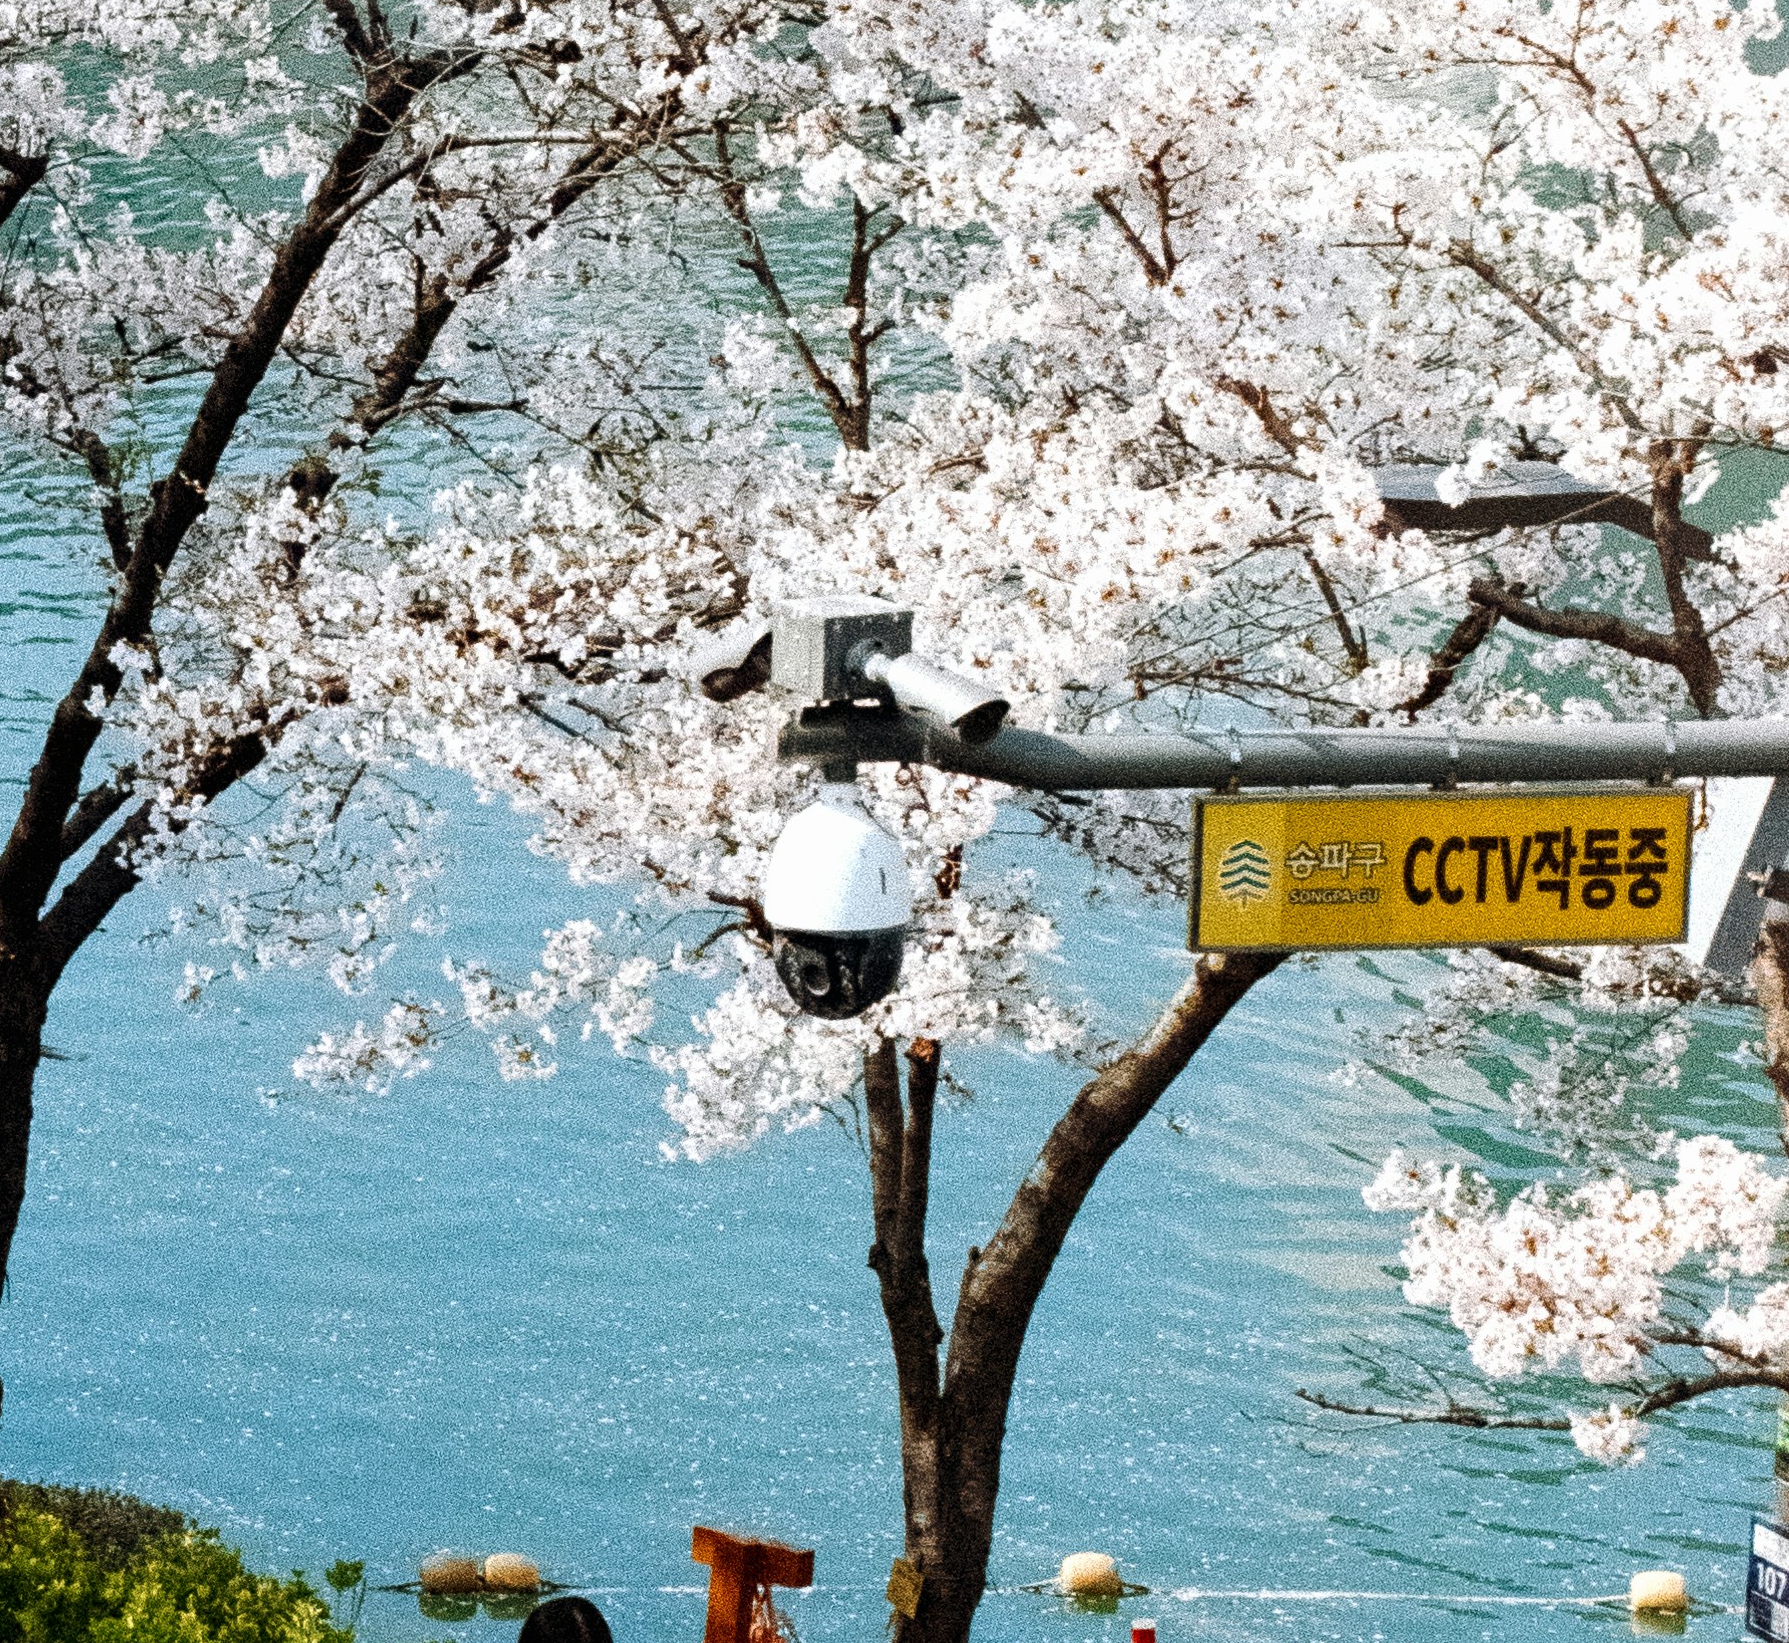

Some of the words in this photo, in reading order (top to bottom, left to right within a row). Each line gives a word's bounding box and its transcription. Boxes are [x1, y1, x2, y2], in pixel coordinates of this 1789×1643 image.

[1286, 842, 1385, 879] 송파구
[1404, 828, 1668, 910] CCTV작동중
[1290, 888, 1379, 904] SONGPA-GU
[1757, 1562, 1786, 1599] 107
